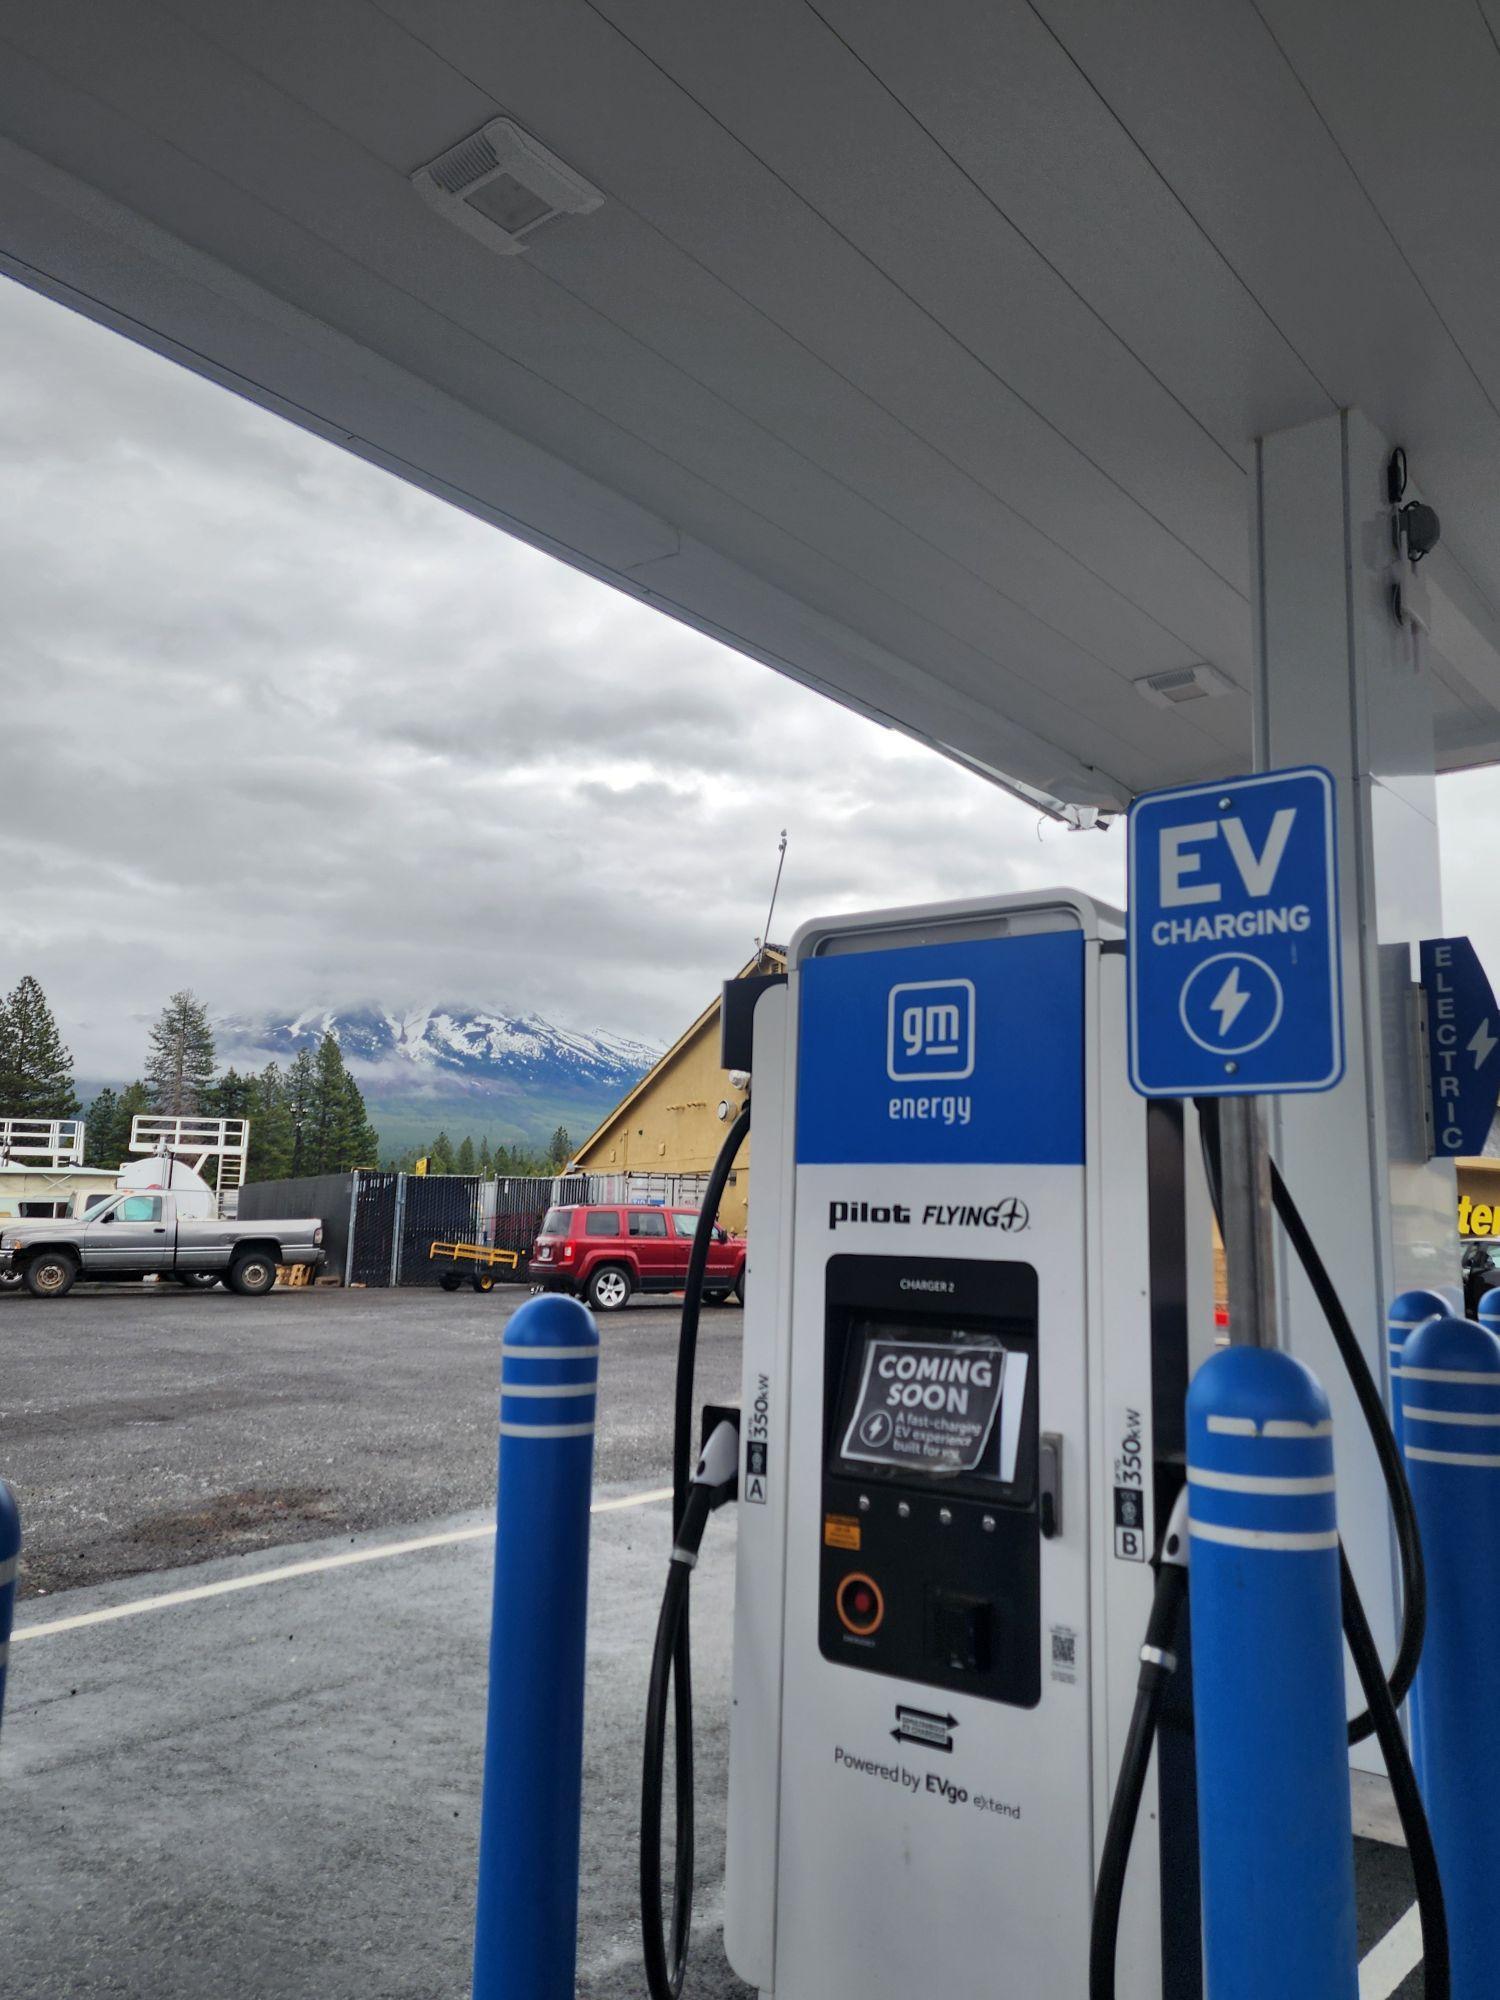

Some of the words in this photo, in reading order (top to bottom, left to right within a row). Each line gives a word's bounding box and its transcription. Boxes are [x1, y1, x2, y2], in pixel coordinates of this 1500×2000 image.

[1159, 808, 1297, 908] EV
[1151, 905, 1312, 946] CHARGING
[902, 1003, 960, 1057] gm
[1434, 946, 1464, 1150] ELECTRIC
[888, 1094, 972, 1126] energy
[899, 1278, 947, 1293] CHARGER
[948, 1281, 955, 1293] 2
[877, 1354, 993, 1388] COMING
[886, 1383, 970, 1416] SOON
[893, 1438, 921, 1456] built
[894, 1424, 911, 1438] EV
[750, 1478, 763, 1499] A
[1123, 1532, 1138, 1556] B
[834, 1745, 899, 1783] Powered
[902, 1767, 921, 1793] by
[926, 1773, 968, 1804] EVgo
[973, 1795, 1021, 1819] extend
